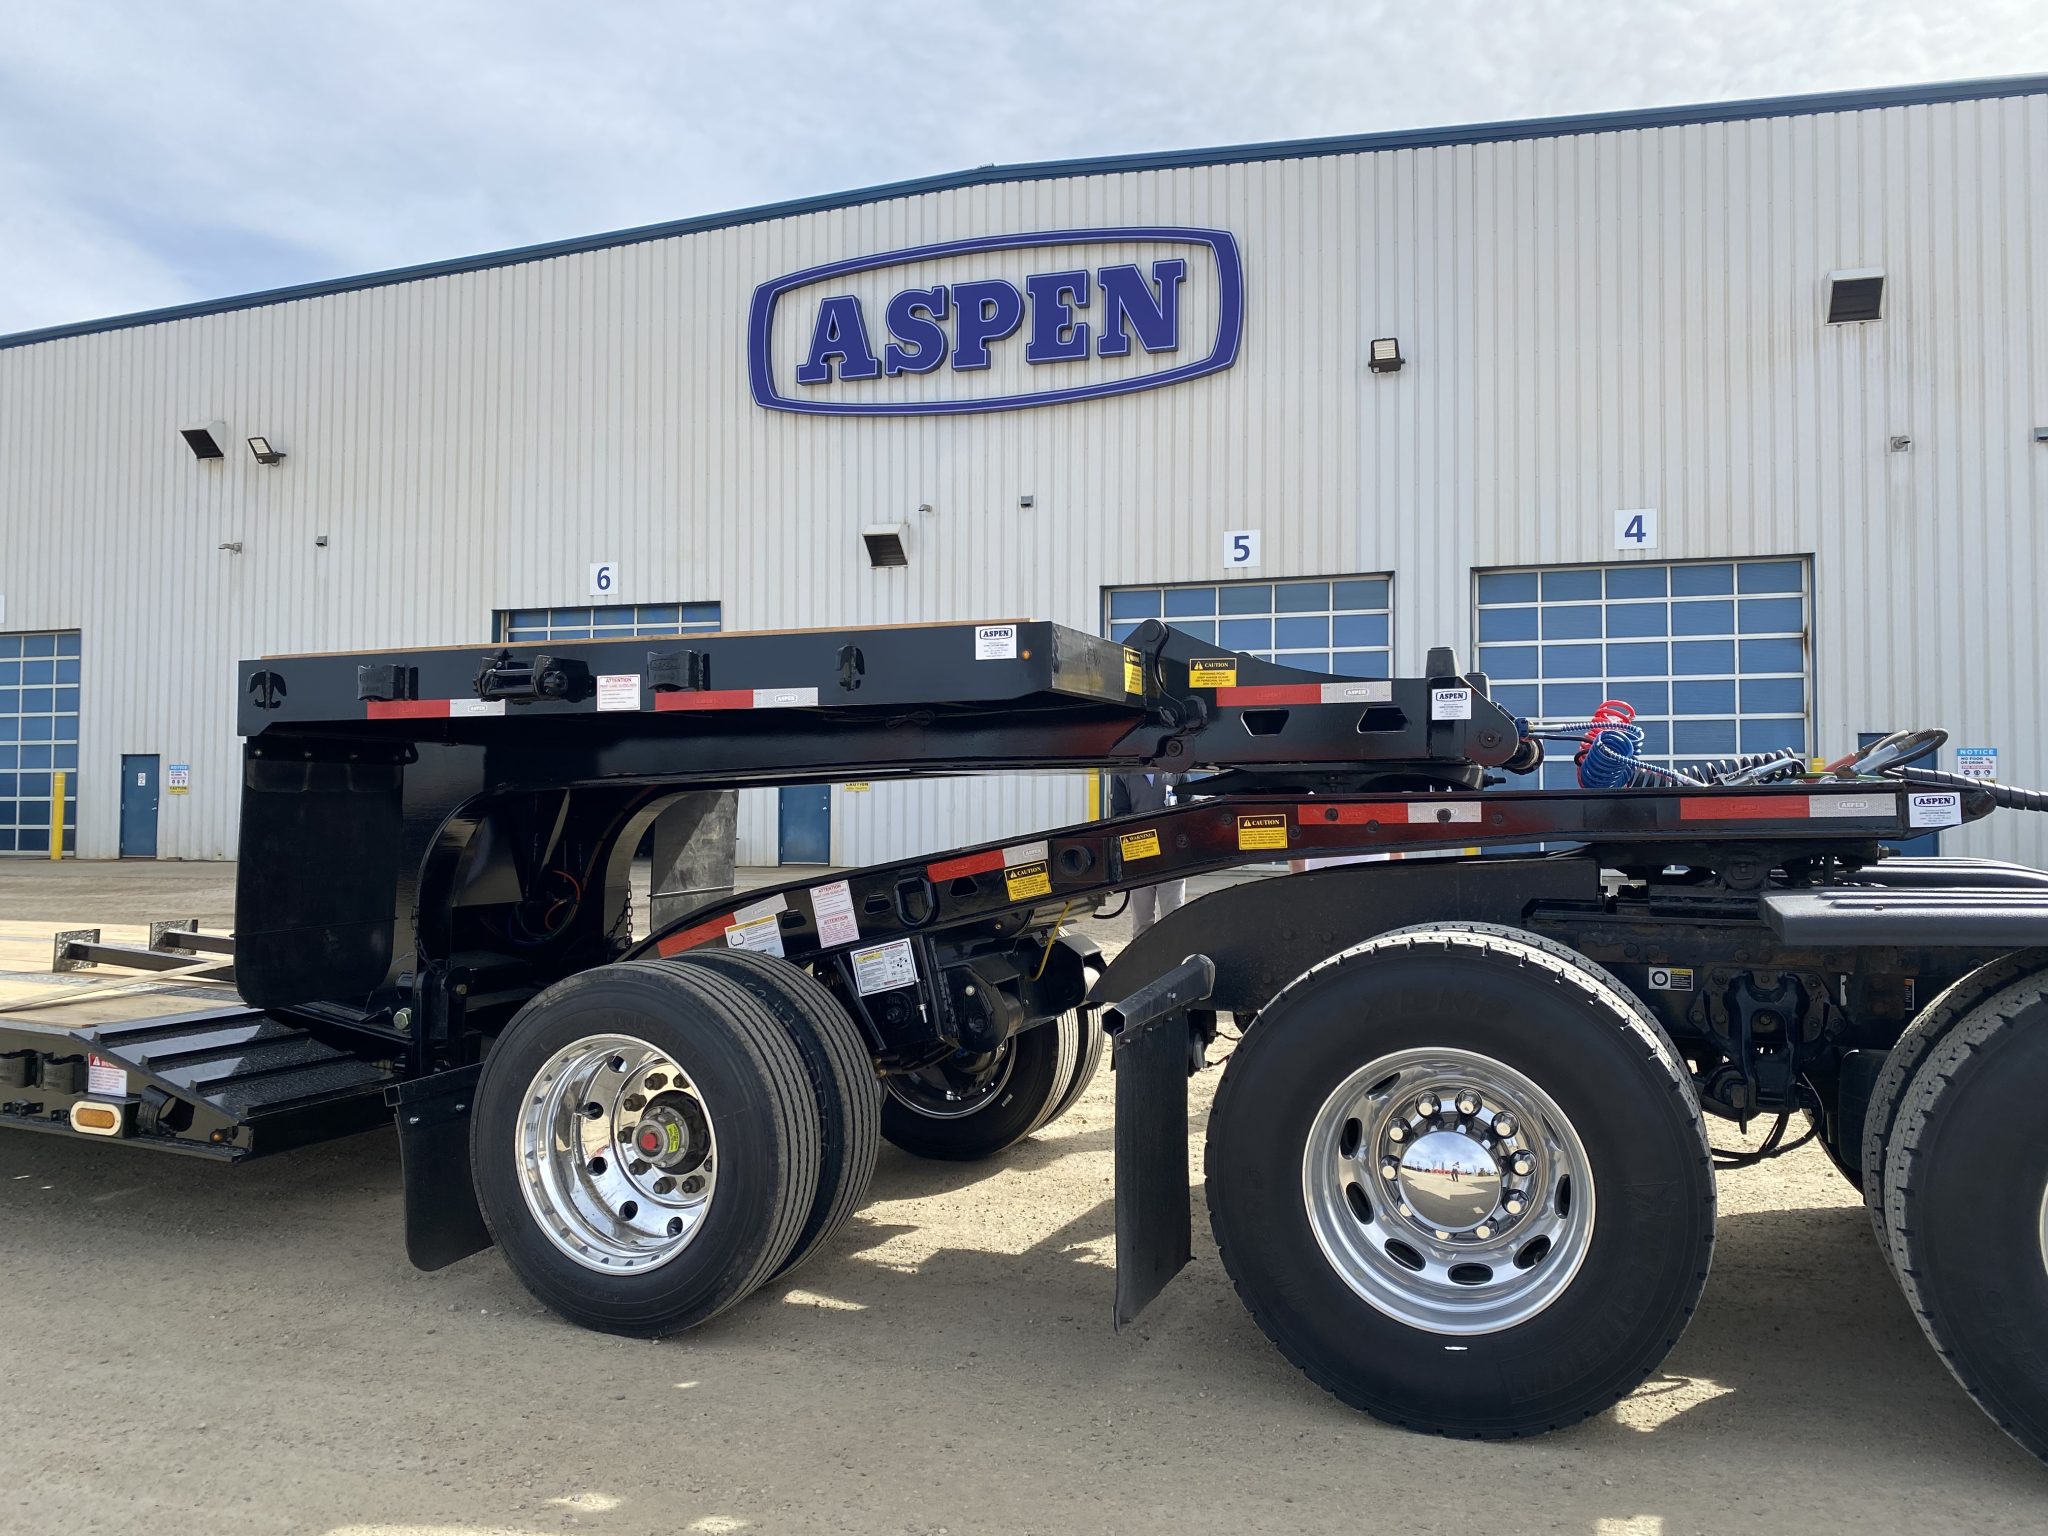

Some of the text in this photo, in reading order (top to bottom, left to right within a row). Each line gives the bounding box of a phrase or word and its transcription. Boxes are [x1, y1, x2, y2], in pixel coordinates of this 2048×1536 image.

[797, 259, 1187, 386] ASPEN
[1624, 515, 1647, 543] 4
[1233, 535, 1250, 562] 5
[596, 566, 611, 591] 6
[982, 630, 1009, 638] ASPEN
[1918, 797, 1951, 805] ASPEN
[1016, 866, 1042, 876] CAUTION
[818, 884, 842, 893] ATTENTION
[823, 915, 849, 925] ATTENTION
